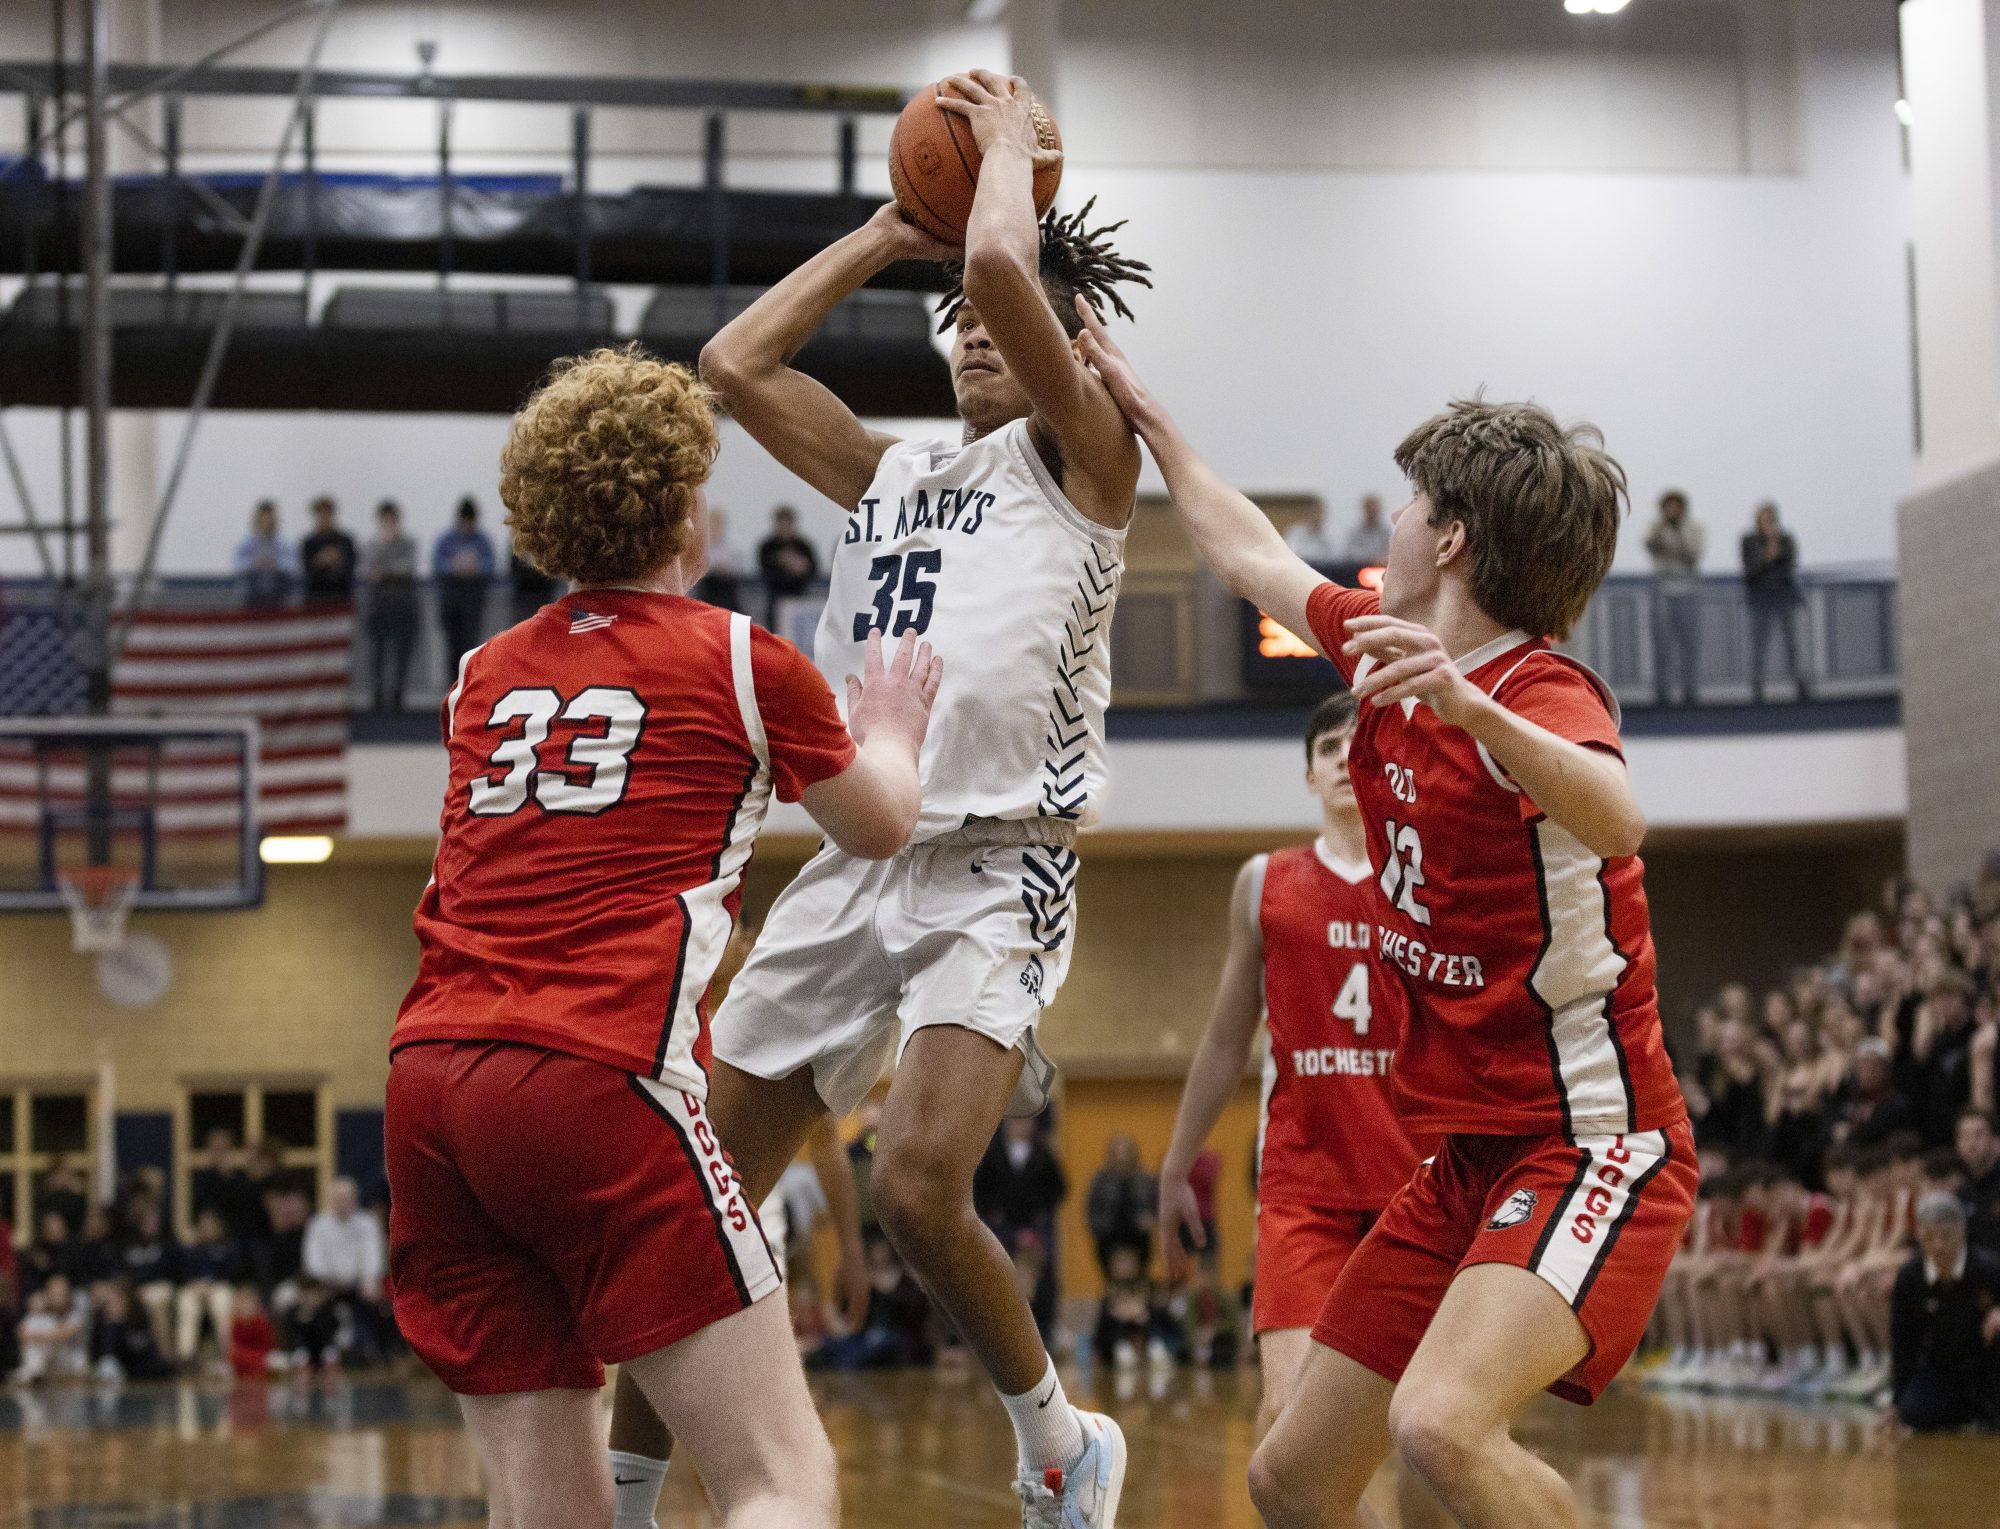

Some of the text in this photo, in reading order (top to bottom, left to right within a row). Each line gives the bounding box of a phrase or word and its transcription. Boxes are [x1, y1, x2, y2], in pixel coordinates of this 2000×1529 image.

[845, 498, 883, 545] ST.
[853, 548, 942, 642] 35
[467, 685, 649, 818] 33
[1379, 817, 1432, 927] 12
[1327, 919, 1371, 950] OLD
[1377, 924, 1485, 988] HESTER
[1332, 961, 1372, 1036] 4
[1292, 1047, 1396, 1076] ROCHEST
